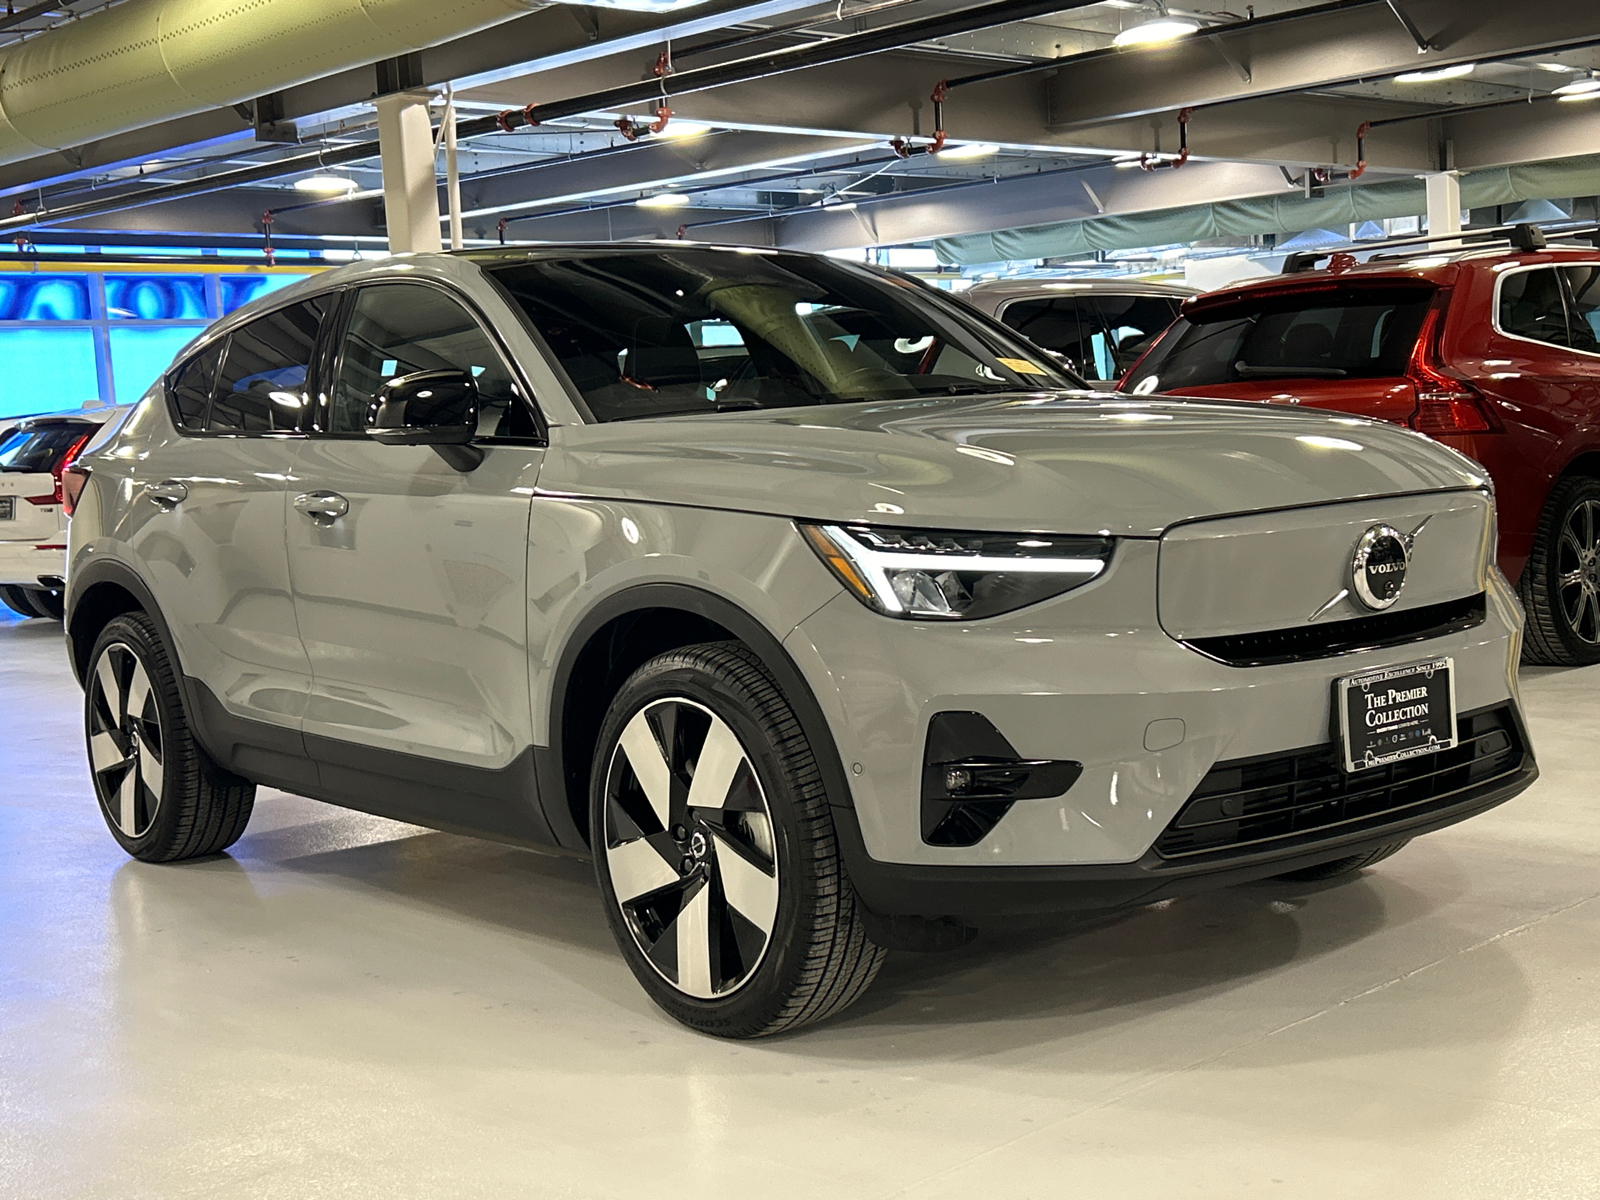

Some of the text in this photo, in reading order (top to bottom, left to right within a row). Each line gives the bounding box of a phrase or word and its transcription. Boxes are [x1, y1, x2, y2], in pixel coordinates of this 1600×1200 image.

[1369, 562, 1405, 574] VOLVO
[1364, 686, 1428, 709] THE PREMIER
[1365, 703, 1429, 727] COLLECTION
